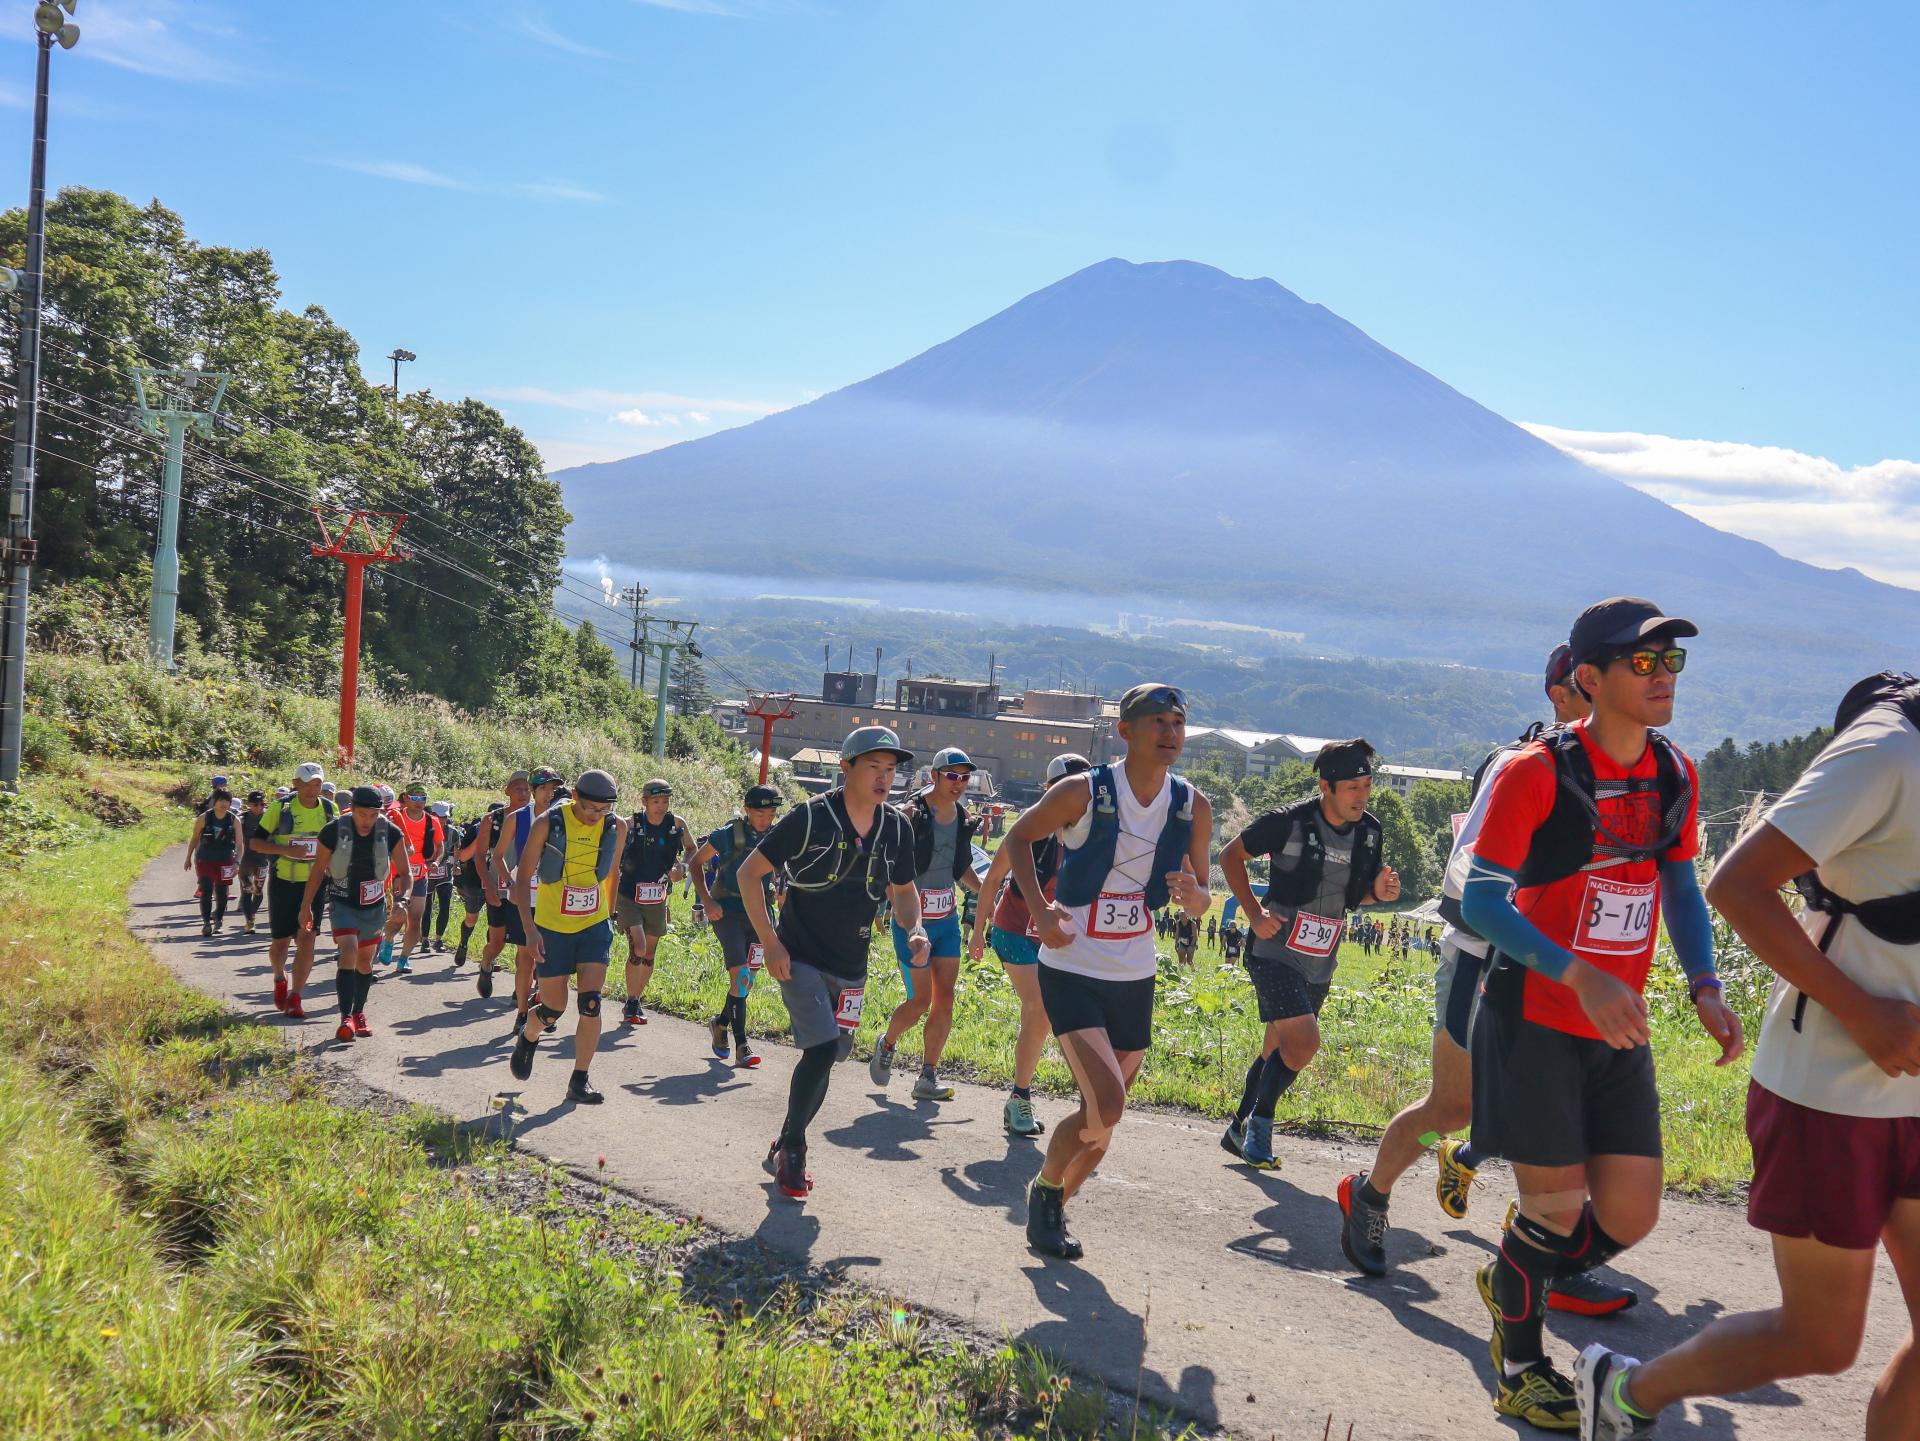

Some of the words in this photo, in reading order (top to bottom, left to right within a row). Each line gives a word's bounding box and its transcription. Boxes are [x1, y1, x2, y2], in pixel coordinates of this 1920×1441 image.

[567, 893, 595, 907] 3-35
[923, 895, 952, 910] 3-104
[1103, 903, 1139, 926] 3-8
[1584, 896, 1654, 931] 3-103
[1298, 923, 1332, 944] 3-99
